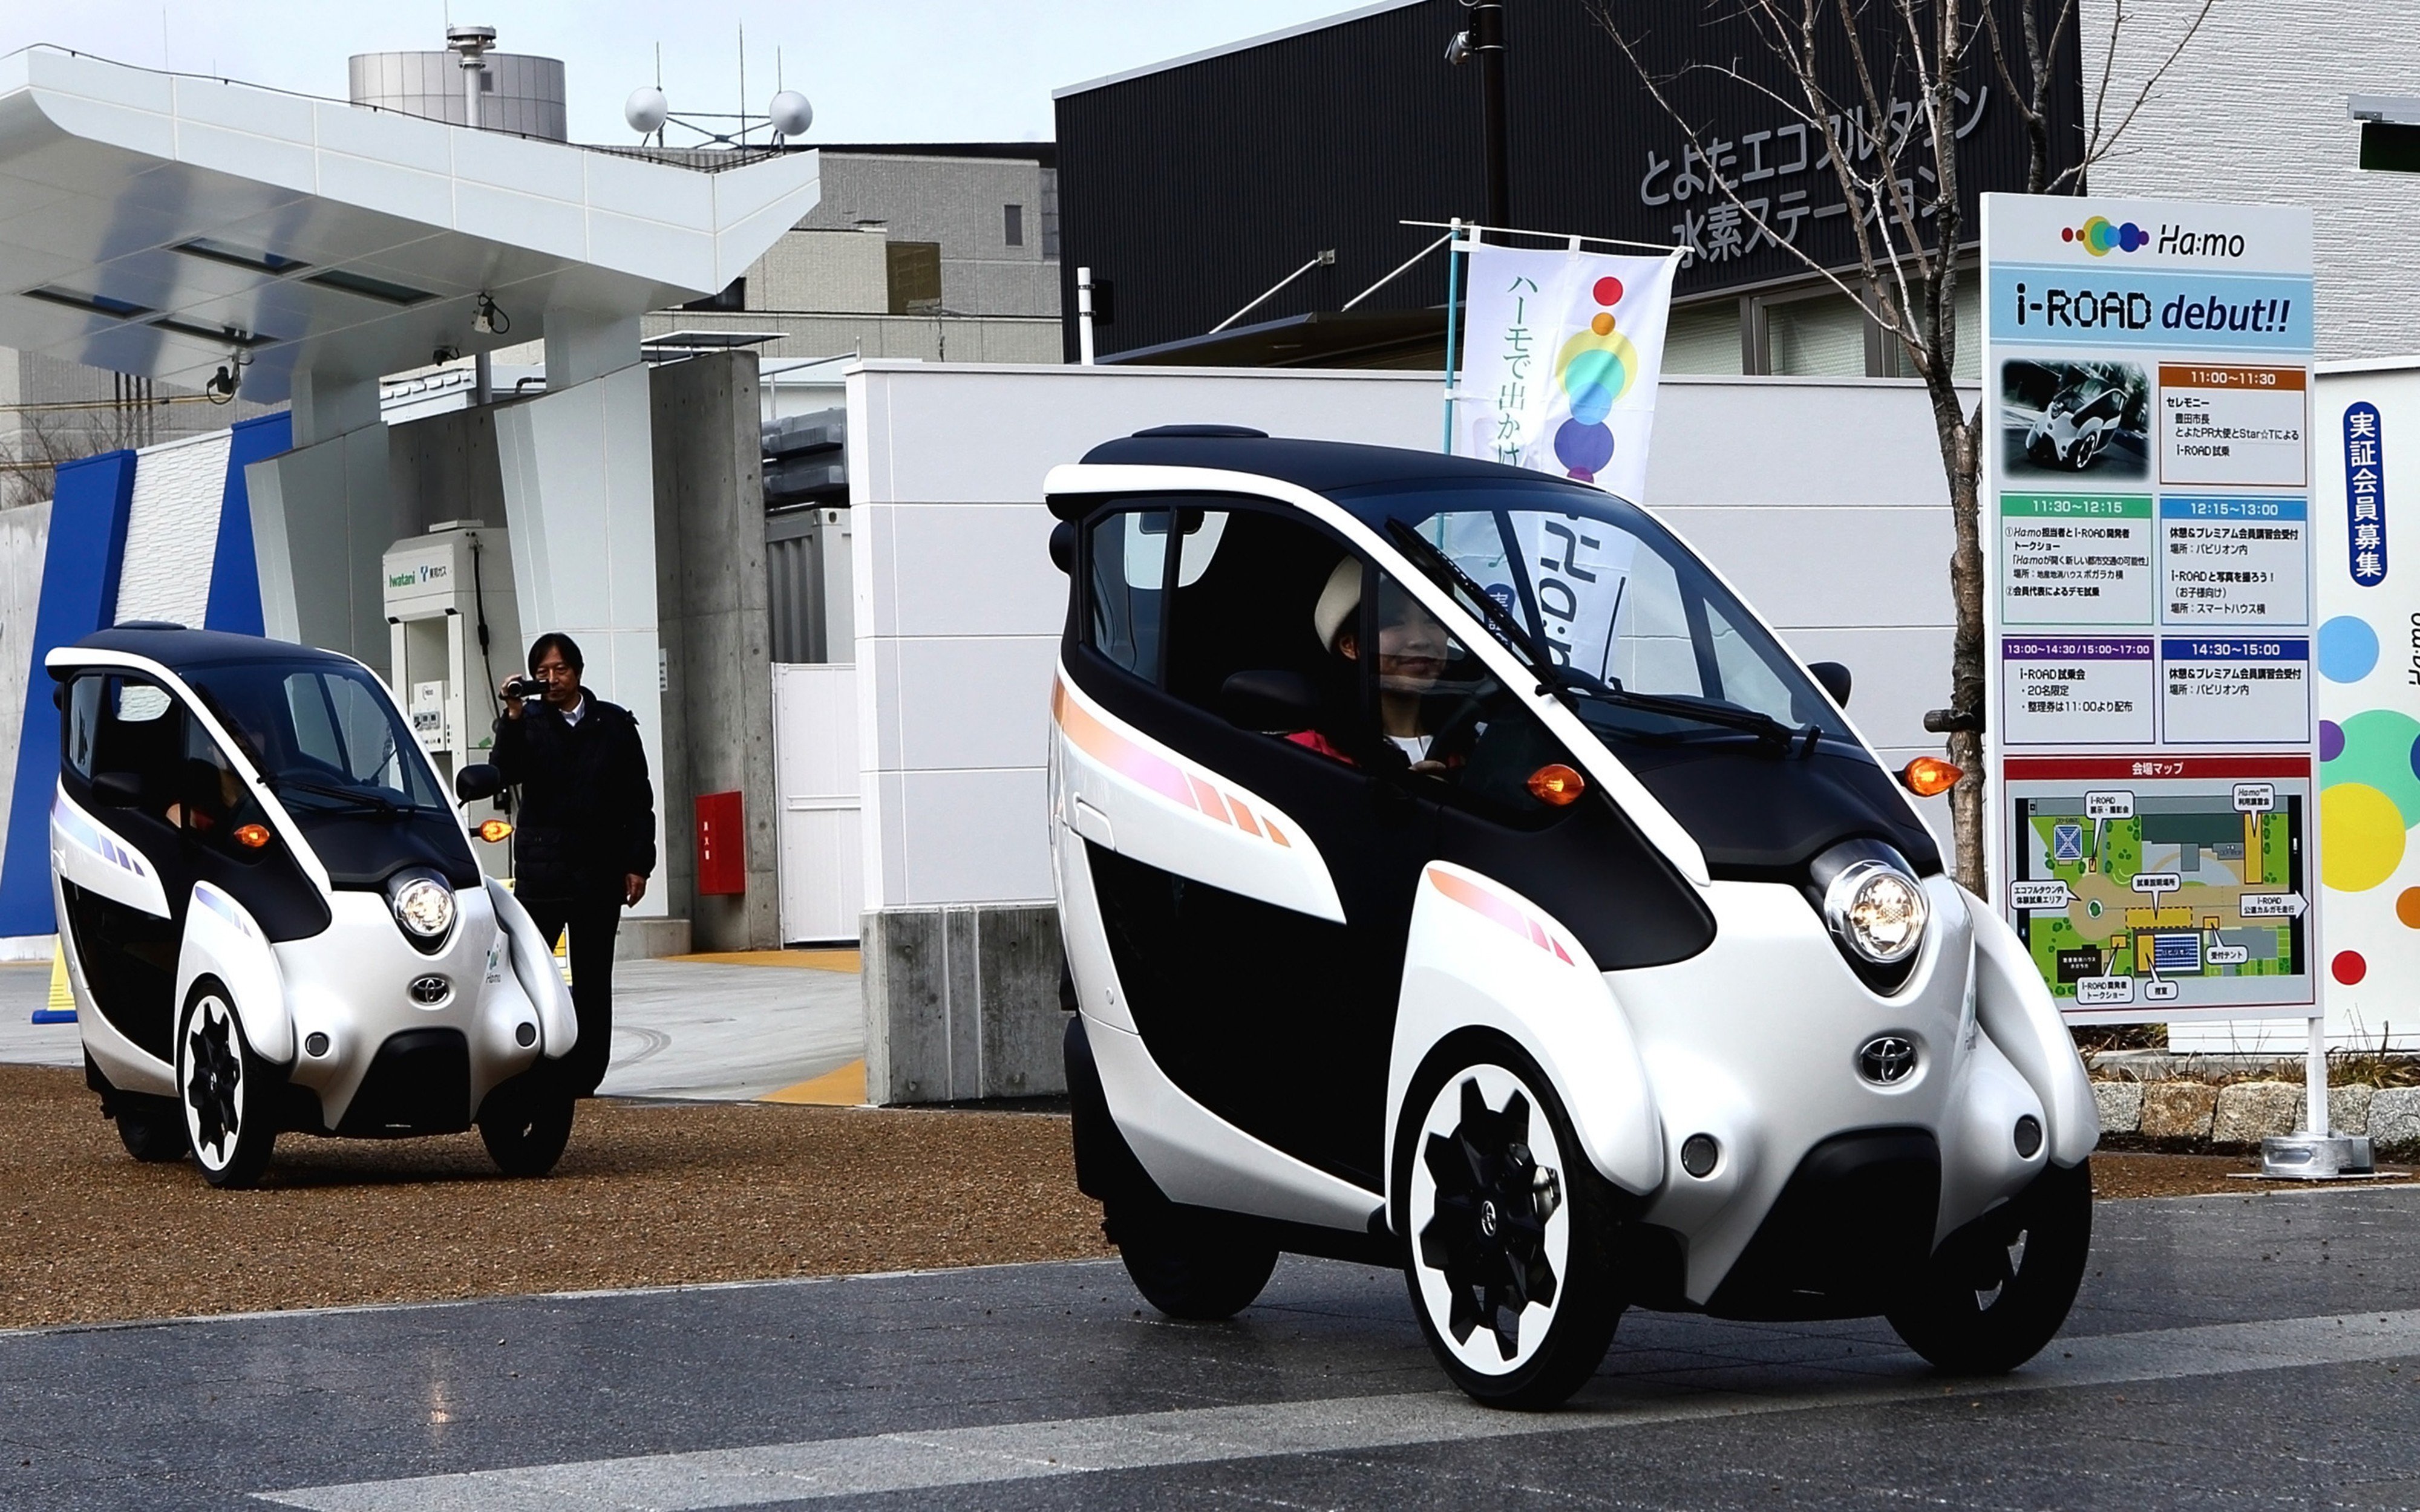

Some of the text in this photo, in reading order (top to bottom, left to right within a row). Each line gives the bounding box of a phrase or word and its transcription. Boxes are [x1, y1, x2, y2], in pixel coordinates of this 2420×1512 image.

[2158, 224, 2245, 257] Ha:mo
[2016, 282, 2291, 332] i-ROAD debut!!
[2166, 397, 2210, 408] セレモニー
[2175, 413, 2210, 425] 豊田市長
[2349, 411, 2382, 578] 実証会員募集
[2015, 542, 2060, 550] トークショー
[2132, 762, 2183, 775] 会場マップ
[2014, 885, 2064, 894] エコフルタウン内
[2087, 991, 2125, 1000] トークショー
